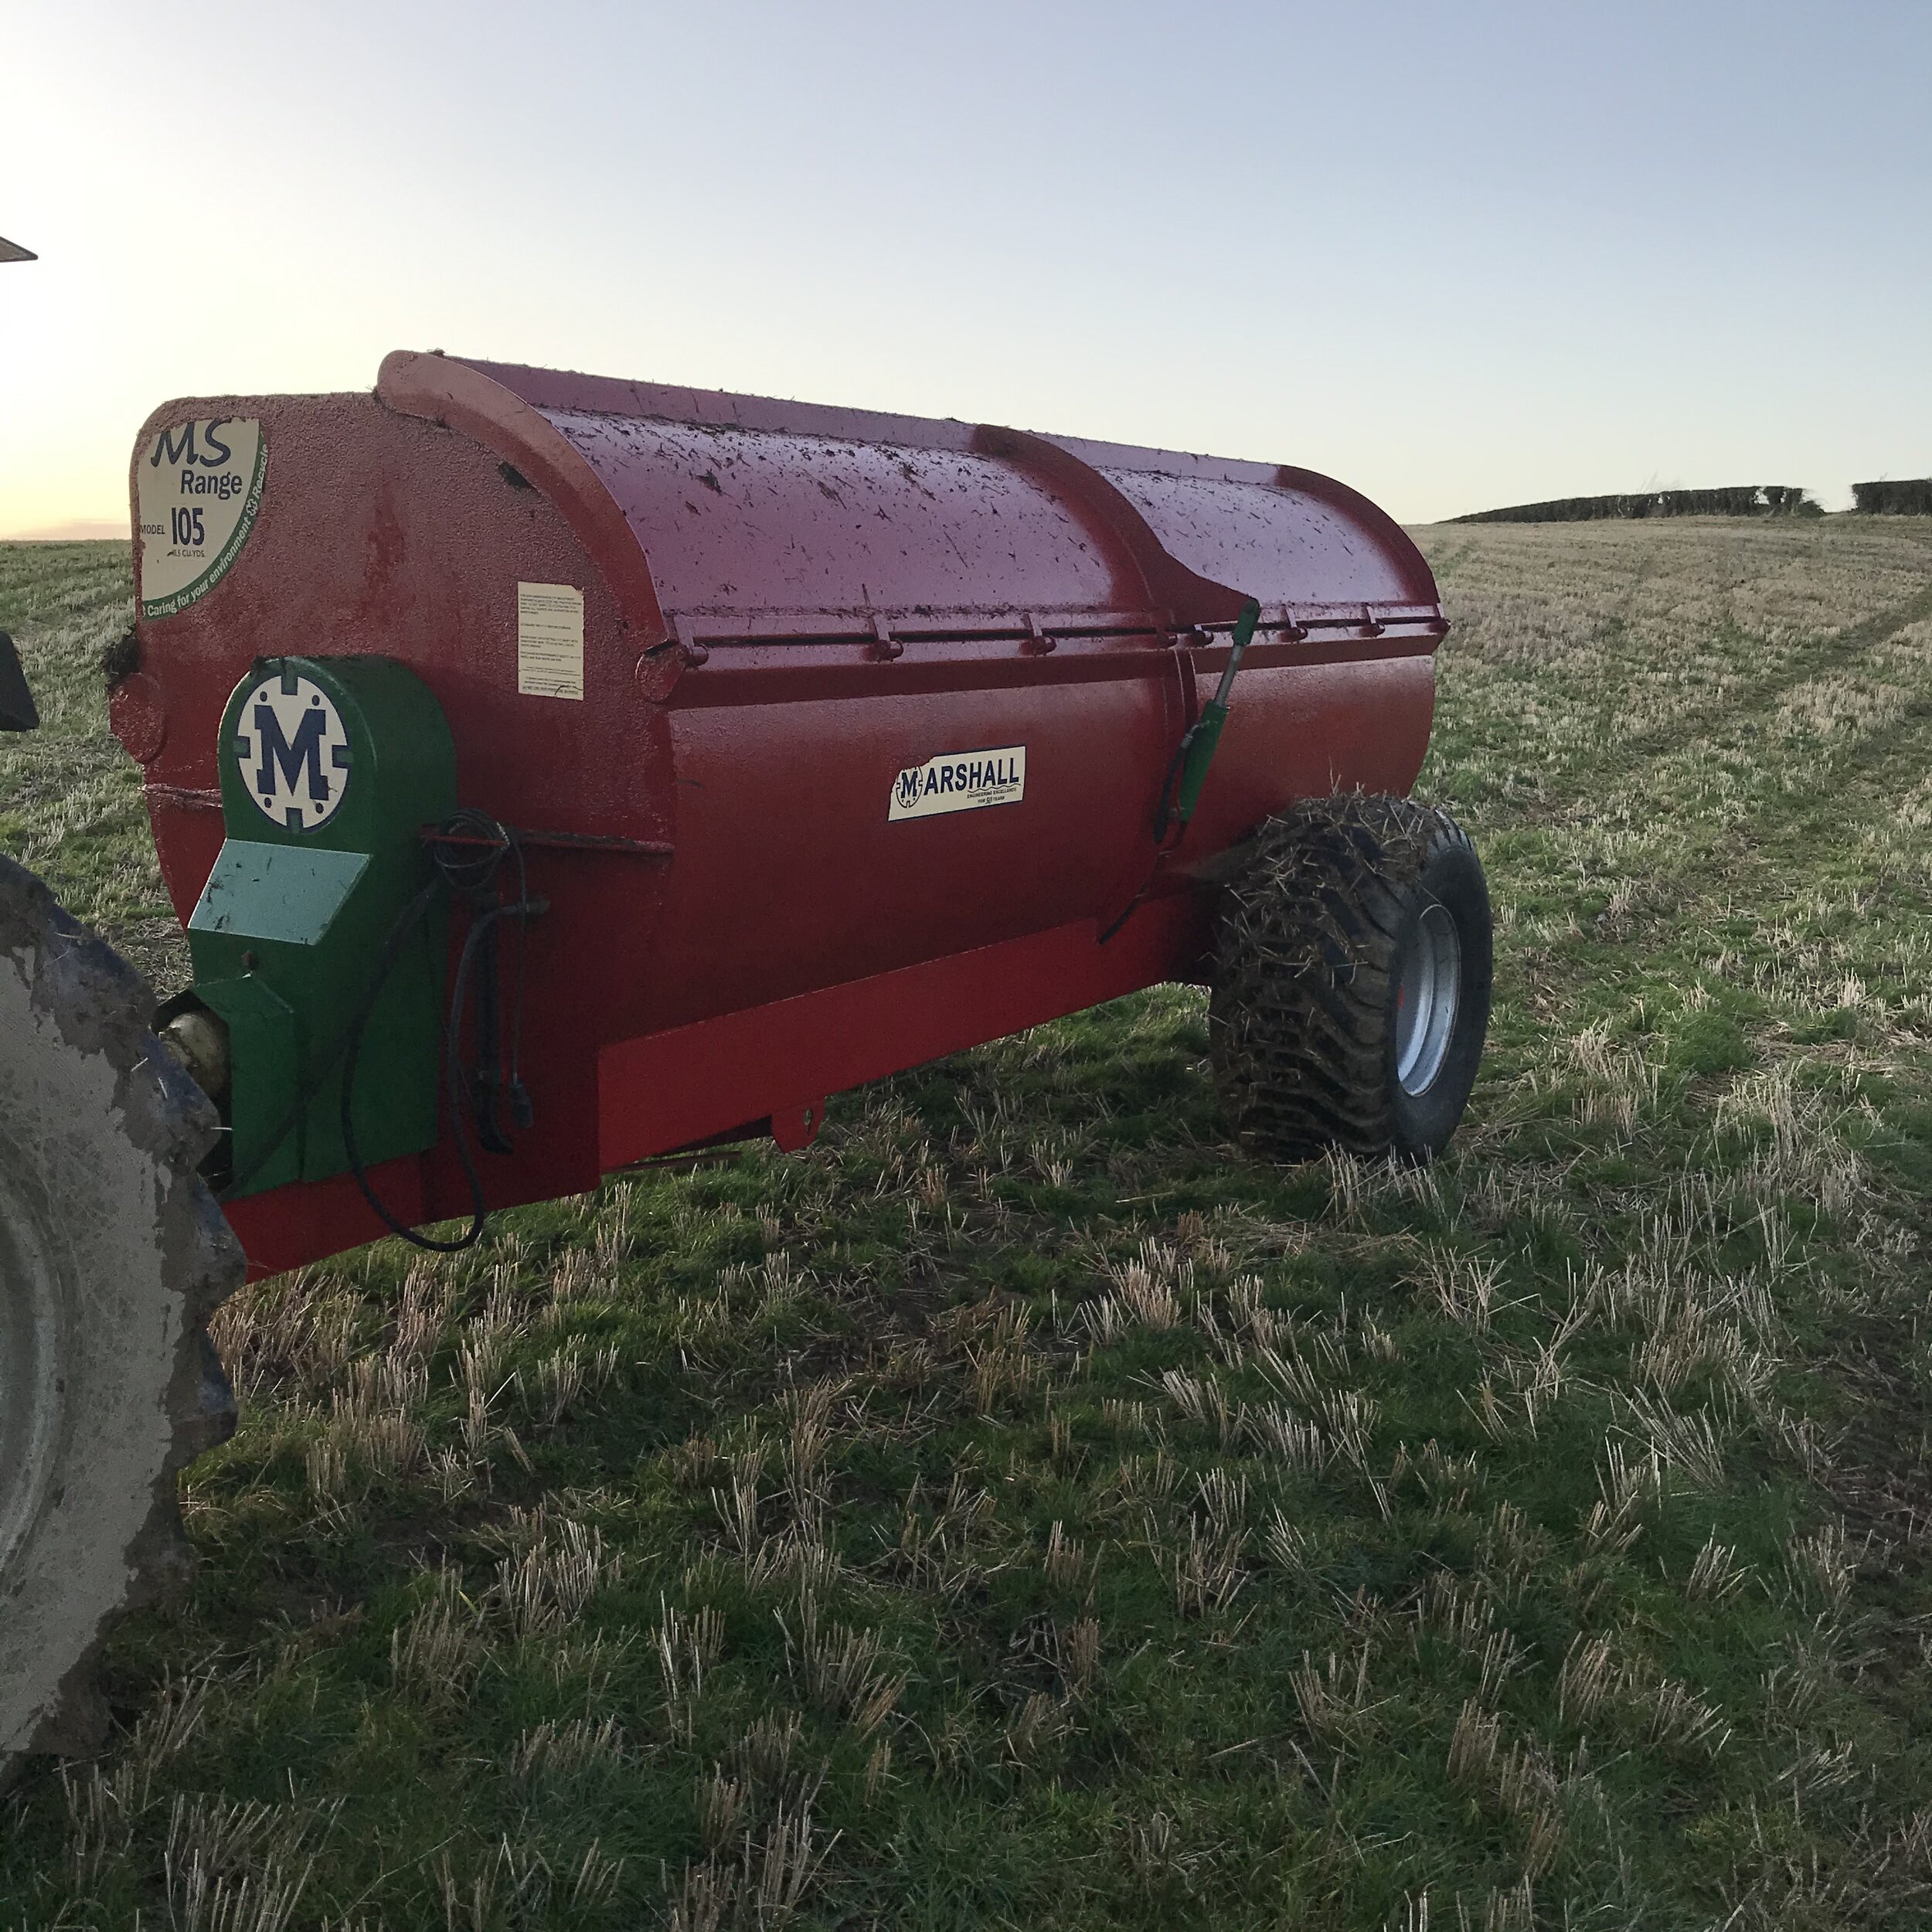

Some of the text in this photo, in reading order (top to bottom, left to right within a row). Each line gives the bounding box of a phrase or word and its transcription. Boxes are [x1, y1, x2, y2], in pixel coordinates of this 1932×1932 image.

[151, 418, 231, 468] MS
[180, 469, 243, 501] Range
[139, 507, 205, 546] MODEL 105
[147, 599, 178, 617] Caring
[176, 594, 190, 608] for
[190, 579, 209, 602] your
[209, 516, 252, 583] environment
[252, 444, 268, 499] Recycle
[254, 704, 329, 801] M
